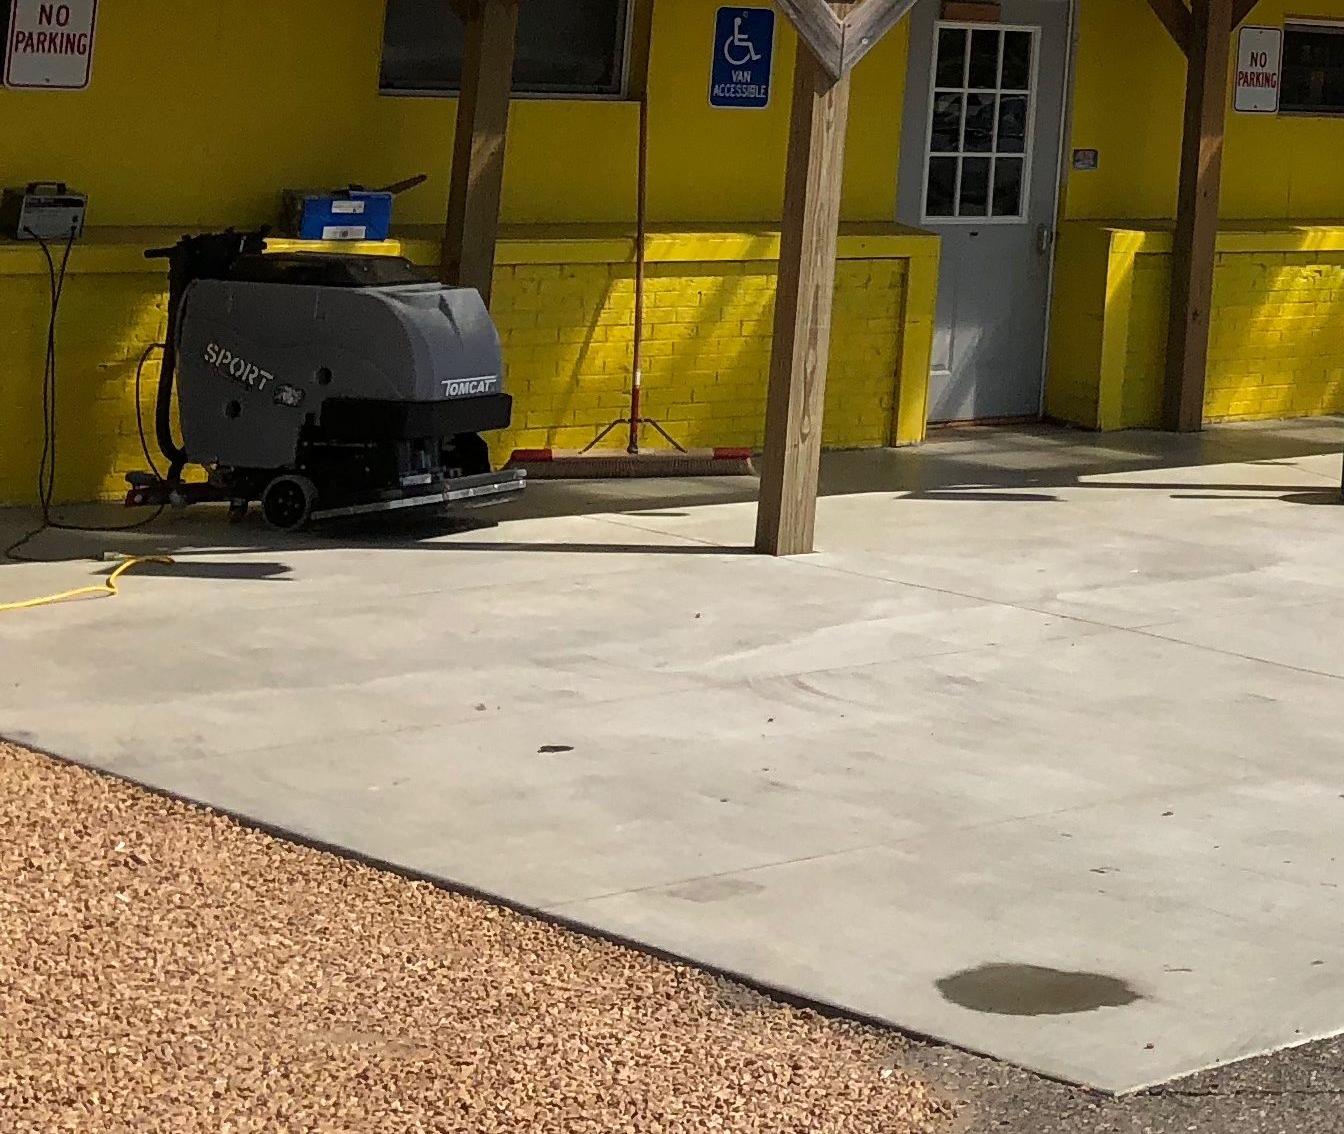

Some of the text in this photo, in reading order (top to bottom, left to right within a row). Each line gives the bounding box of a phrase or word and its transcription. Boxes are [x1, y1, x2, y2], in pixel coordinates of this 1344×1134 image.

[38, 4, 70, 27] NO
[14, 29, 88, 56] PARKING
[1250, 51, 1267, 68] NO
[731, 69, 752, 83] VAN
[1238, 70, 1277, 88] PARKING
[713, 83, 767, 98] ACCESSIBLE
[204, 342, 275, 391] SPORT
[441, 375, 497, 397] TOMCAT
